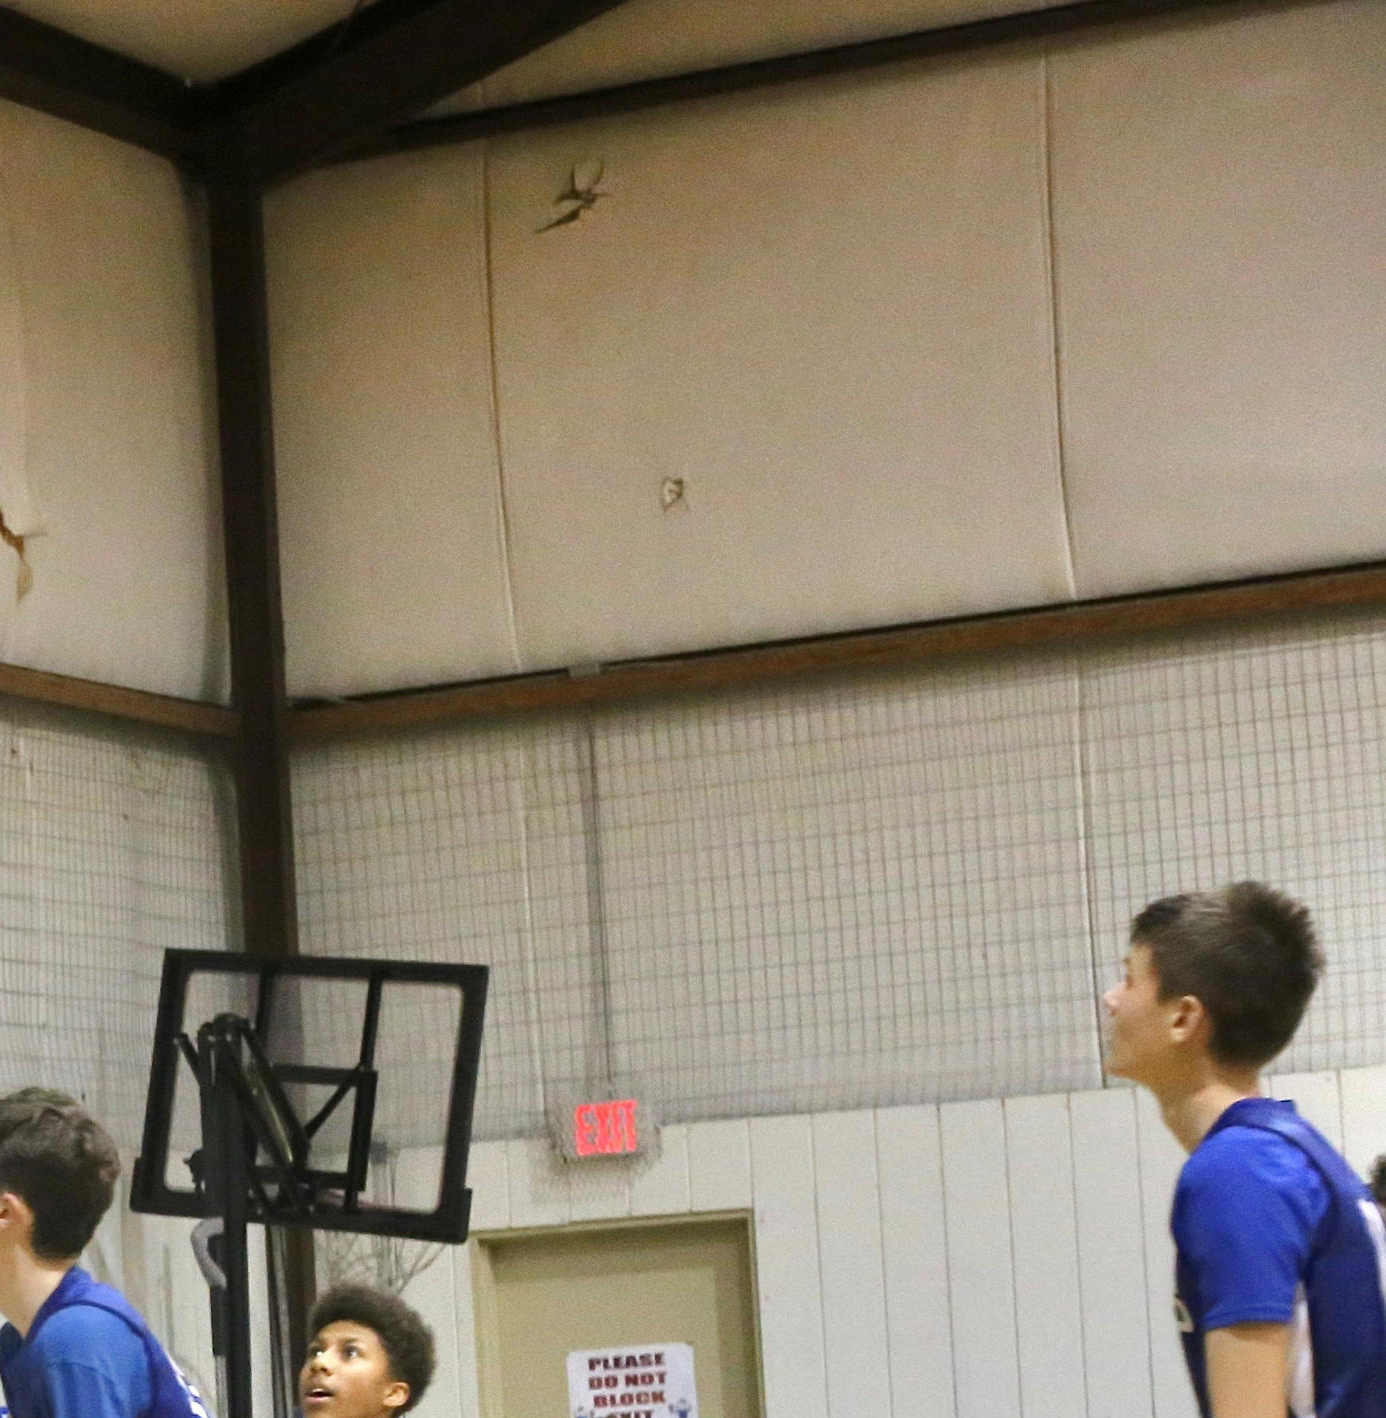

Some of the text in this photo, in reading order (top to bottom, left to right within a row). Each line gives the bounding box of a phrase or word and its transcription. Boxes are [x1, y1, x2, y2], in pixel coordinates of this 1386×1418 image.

[575, 1100, 637, 1155] EXIT
[588, 1352, 663, 1370] PLEASE
[589, 1372, 665, 1389] DO NOT
[593, 1391, 664, 1408] BLOCK
